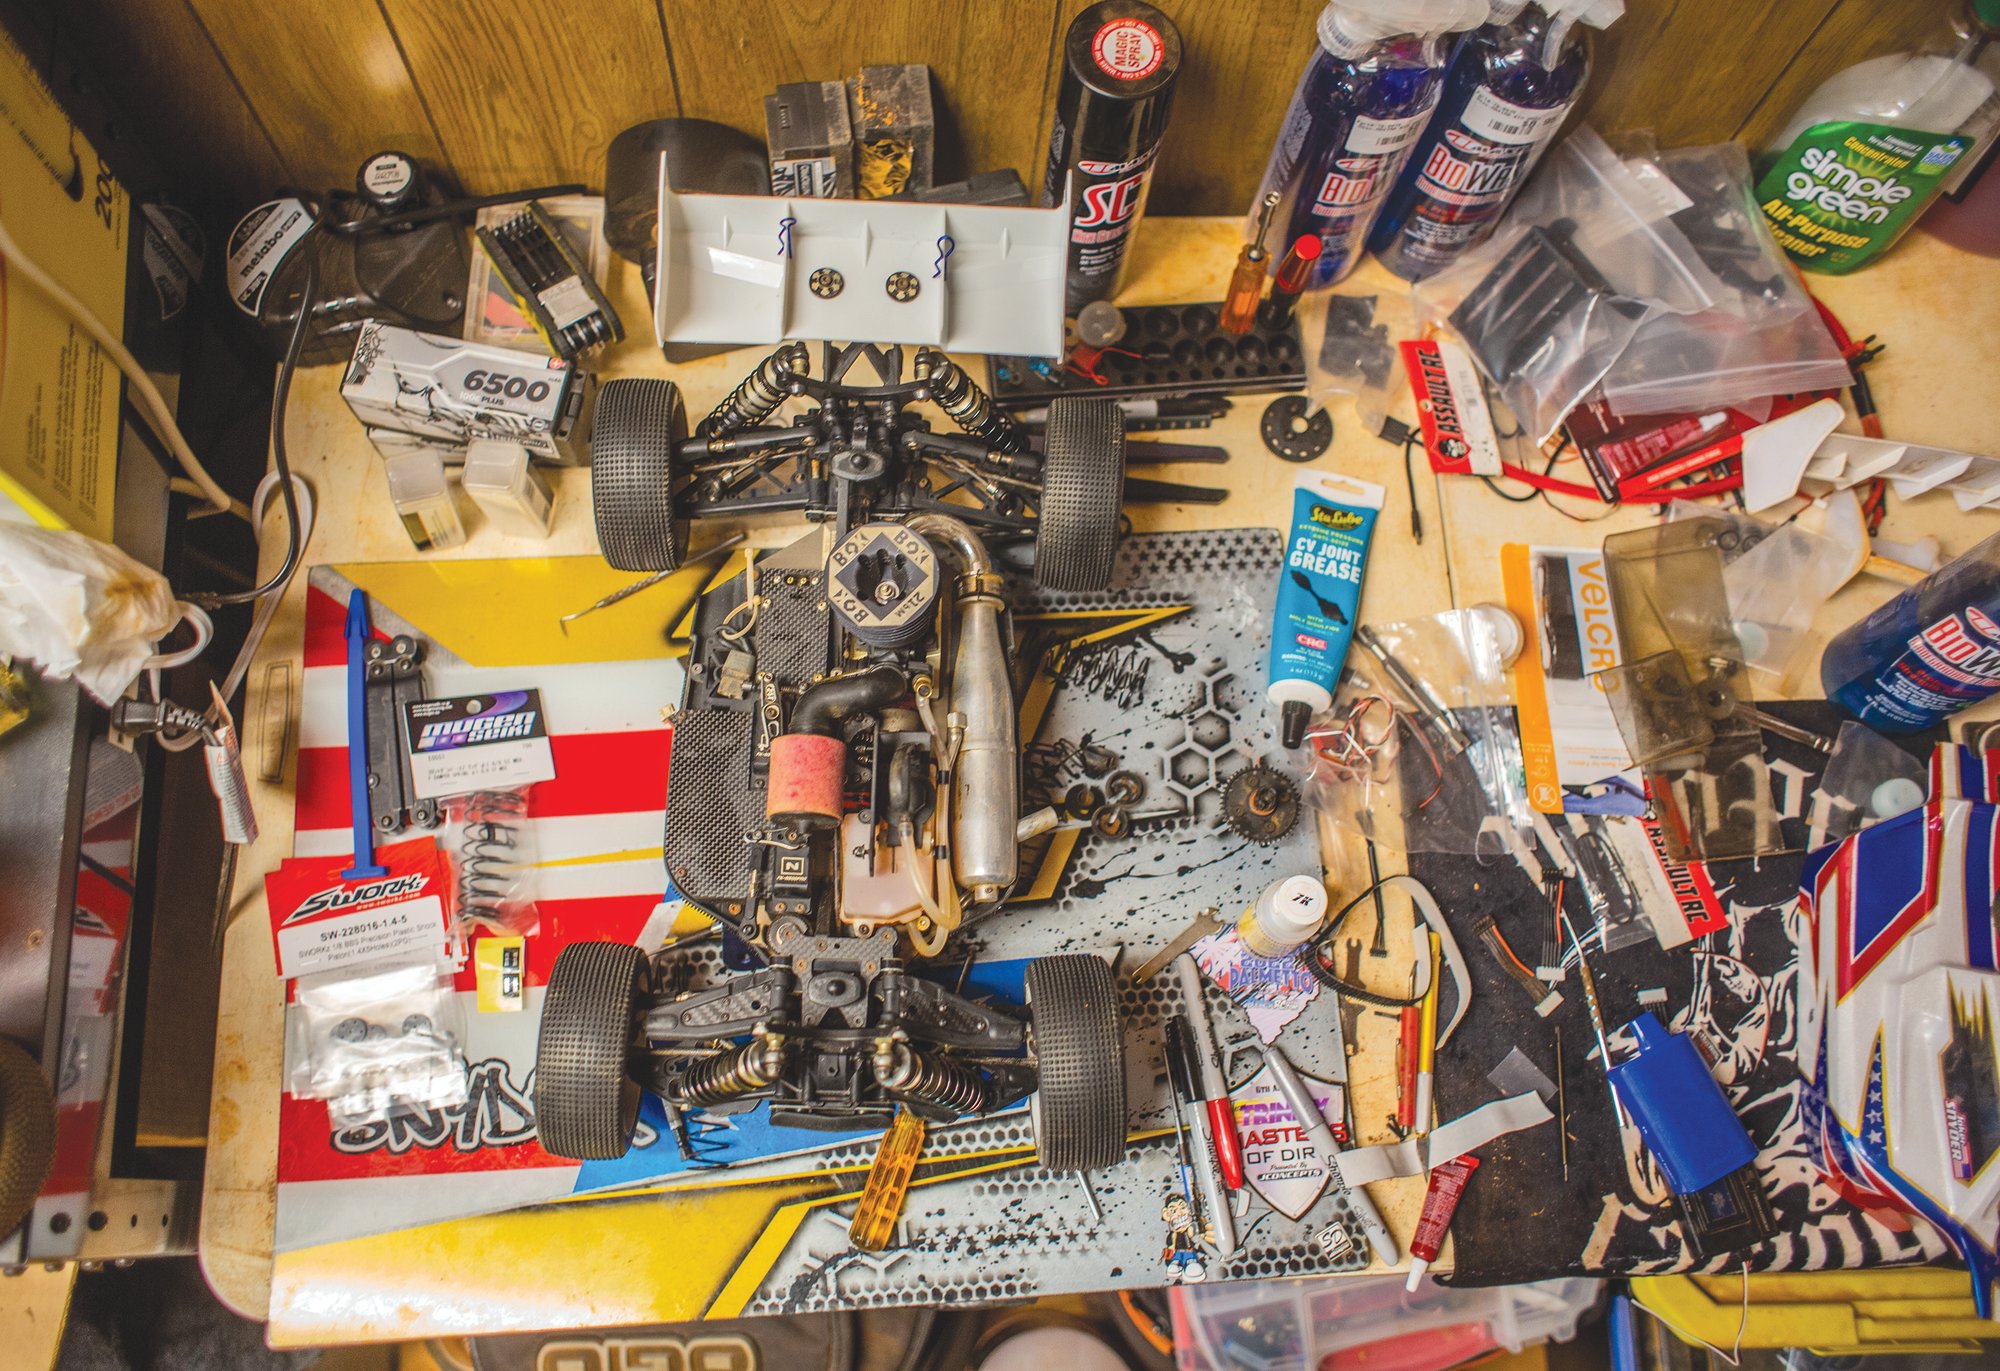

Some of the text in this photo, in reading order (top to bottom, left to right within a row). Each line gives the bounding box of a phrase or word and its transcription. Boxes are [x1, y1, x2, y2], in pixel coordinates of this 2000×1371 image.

[1115, 31, 1128, 66] MAGIC
[1128, 32, 1142, 68] SPRAY
[1844, 136, 1911, 169] Concentrated
[1800, 147, 1912, 203] simple
[1787, 172, 1889, 224] green
[1762, 199, 1871, 249] All-Purpose
[240, 230, 285, 278] metabo
[463, 369, 551, 402] 6500
[1418, 348, 1461, 434] ASSAULT RC
[1289, 550, 1361, 584] GREASE
[1296, 536, 1361, 566] CV JOINT
[420, 711, 536, 737] mugen
[320, 914, 408, 942] SW-228016-1.4-5
[1681, 900, 1711, 924] RC
[1229, 967, 1314, 993] PALMETTO
[1240, 1097, 1329, 1126] TRINY
[1238, 1122, 1348, 1149] ASTES
[1945, 1100, 1962, 1161] SNYDER
[1247, 1147, 1316, 1165] OF DIR
[1259, 1169, 1321, 1181] JCONCEPTS
[1327, 1155, 1352, 1196] Sharpie
[1353, 1205, 1378, 1231] Silver
